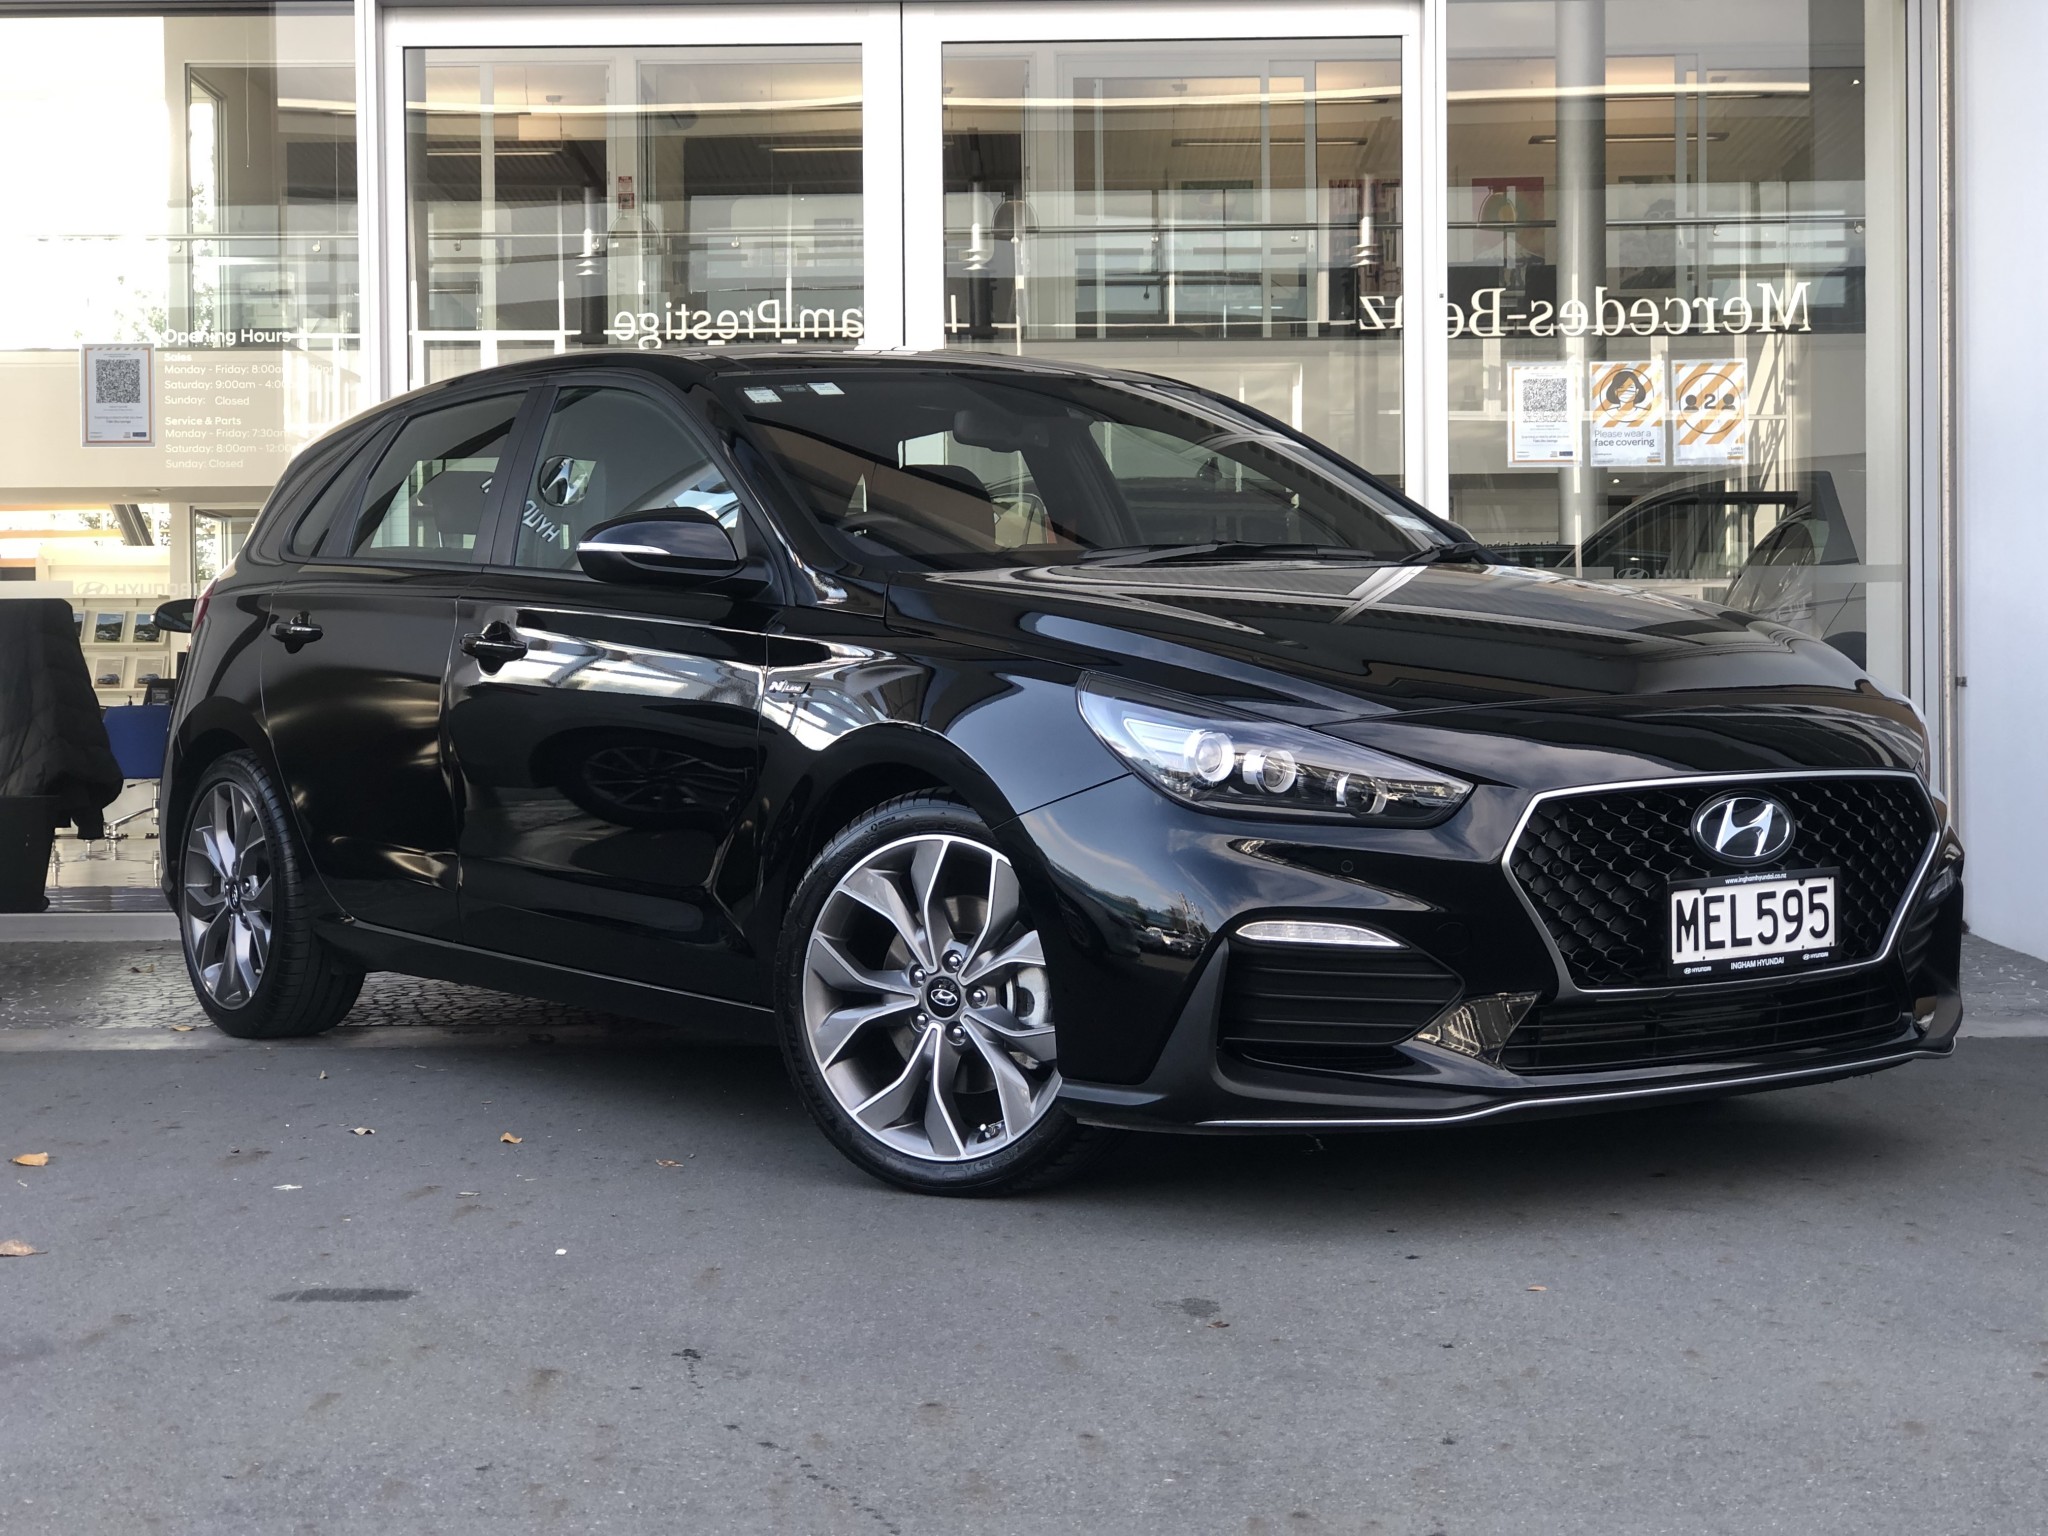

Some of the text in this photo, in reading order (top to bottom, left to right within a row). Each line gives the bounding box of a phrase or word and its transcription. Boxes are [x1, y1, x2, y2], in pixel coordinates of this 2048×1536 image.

[164, 328, 291, 345] Opening Hours
[163, 352, 192, 362] Sales
[164, 365, 206, 376] Monday
[215, 365, 250, 376] Friday:
[251, 365, 284, 374] 8:00a
[164, 380, 213, 391] Saturday:
[215, 380, 256, 390] 9:00am
[164, 395, 250, 406] Sunday: Closed
[1703, 393, 1717, 410] 2
[164, 416, 242, 426] Service & Parts
[165, 429, 207, 440] Monday
[216, 429, 250, 440] Friday:
[1594, 430, 1623, 438] Please
[1594, 438, 1655, 448] face covering
[165, 444, 214, 455] Saturday:
[216, 444, 257, 453] 8:00am
[165, 459, 244, 470] Sunday: Closed
[1725, 872, 1787, 884] www.inghamhyundai.co.nz
[1676, 885, 1830, 953] MEL595
[1809, 951, 1829, 959] HYUNDAI
[1691, 965, 1712, 973] HYUNDAI
[1730, 956, 1785, 971] INGHAM HYUNDAI
